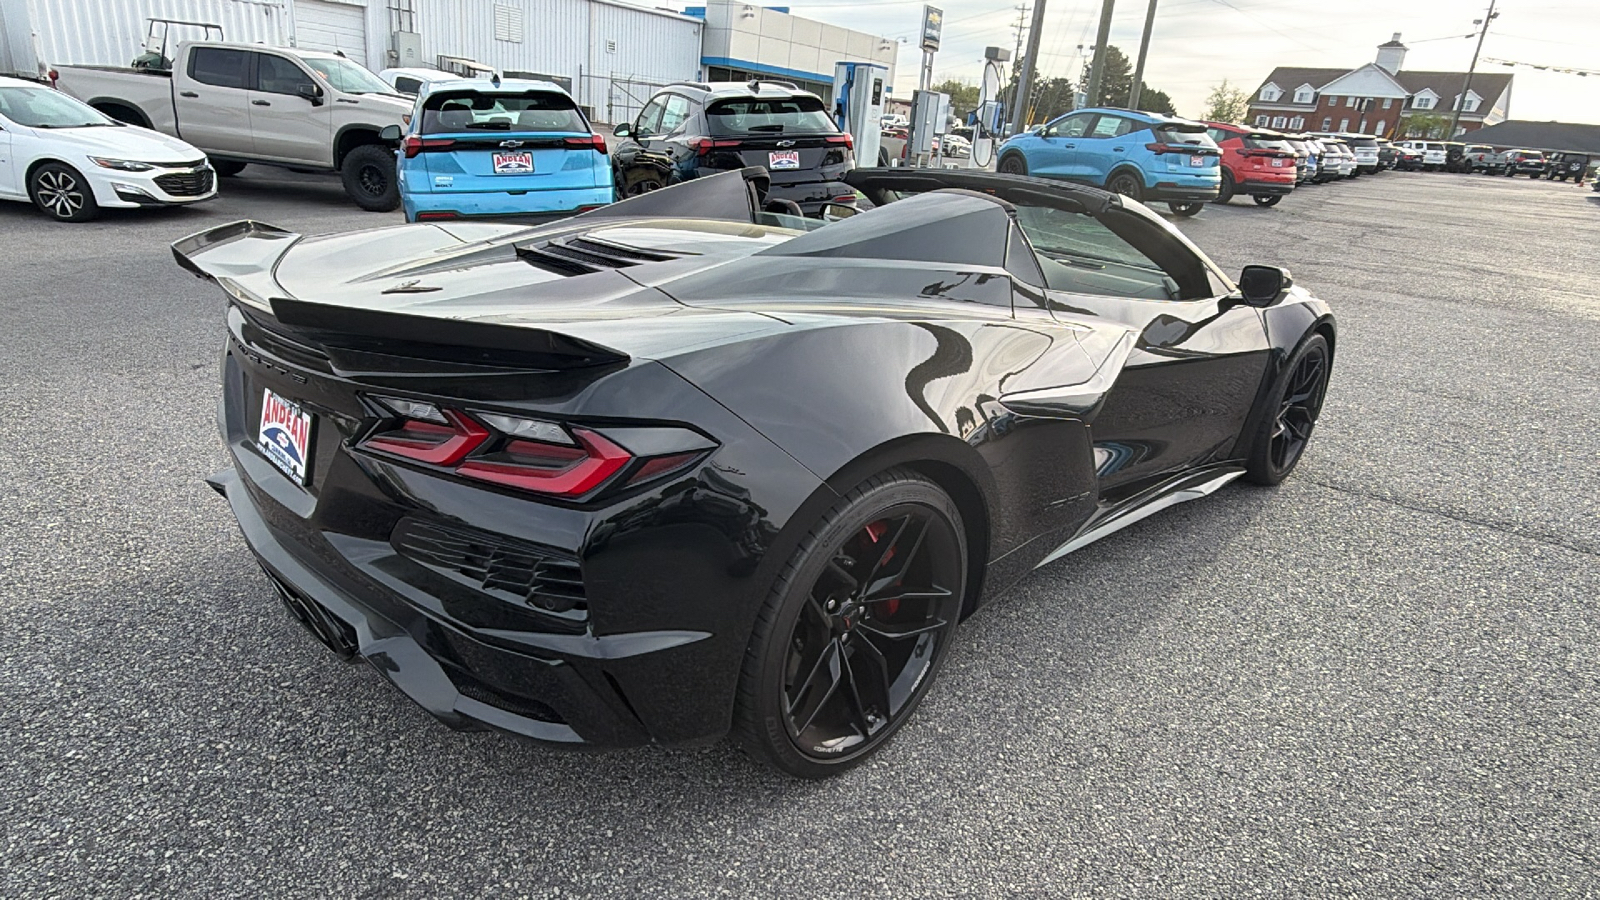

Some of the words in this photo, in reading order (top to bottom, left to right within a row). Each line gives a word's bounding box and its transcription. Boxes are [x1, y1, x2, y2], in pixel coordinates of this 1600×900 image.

[496, 155, 531, 167] ANDEAN
[771, 153, 797, 163] ANDEAN
[262, 393, 309, 460] ANDEAN
